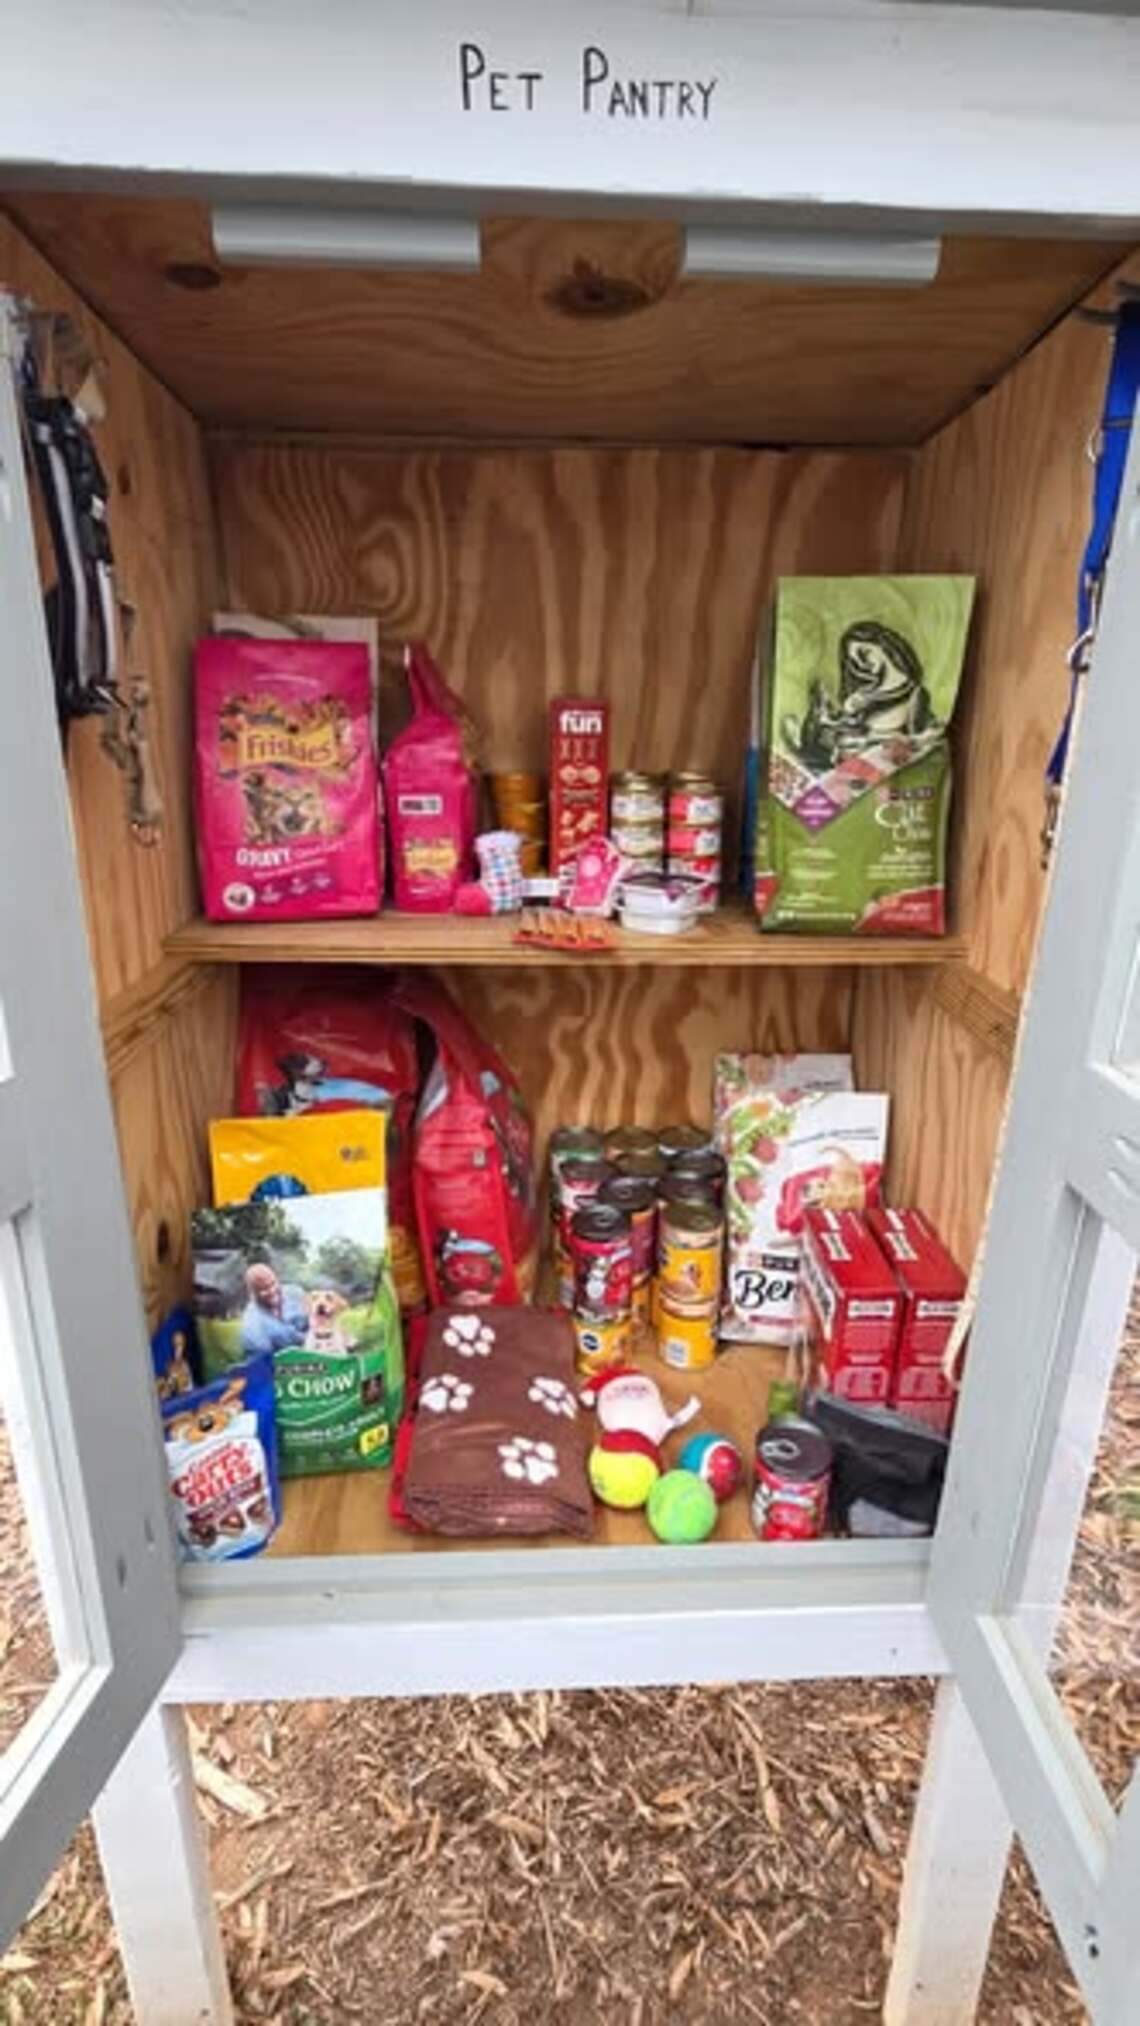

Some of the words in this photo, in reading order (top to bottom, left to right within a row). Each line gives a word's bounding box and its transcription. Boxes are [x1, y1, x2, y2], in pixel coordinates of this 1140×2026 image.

[459, 43, 543, 111] PET
[582, 46, 718, 120] PANTRY
[559, 711, 602, 734] fun
[246, 733, 333, 763] Friskies
[287, 1369, 355, 1399] CHOW
